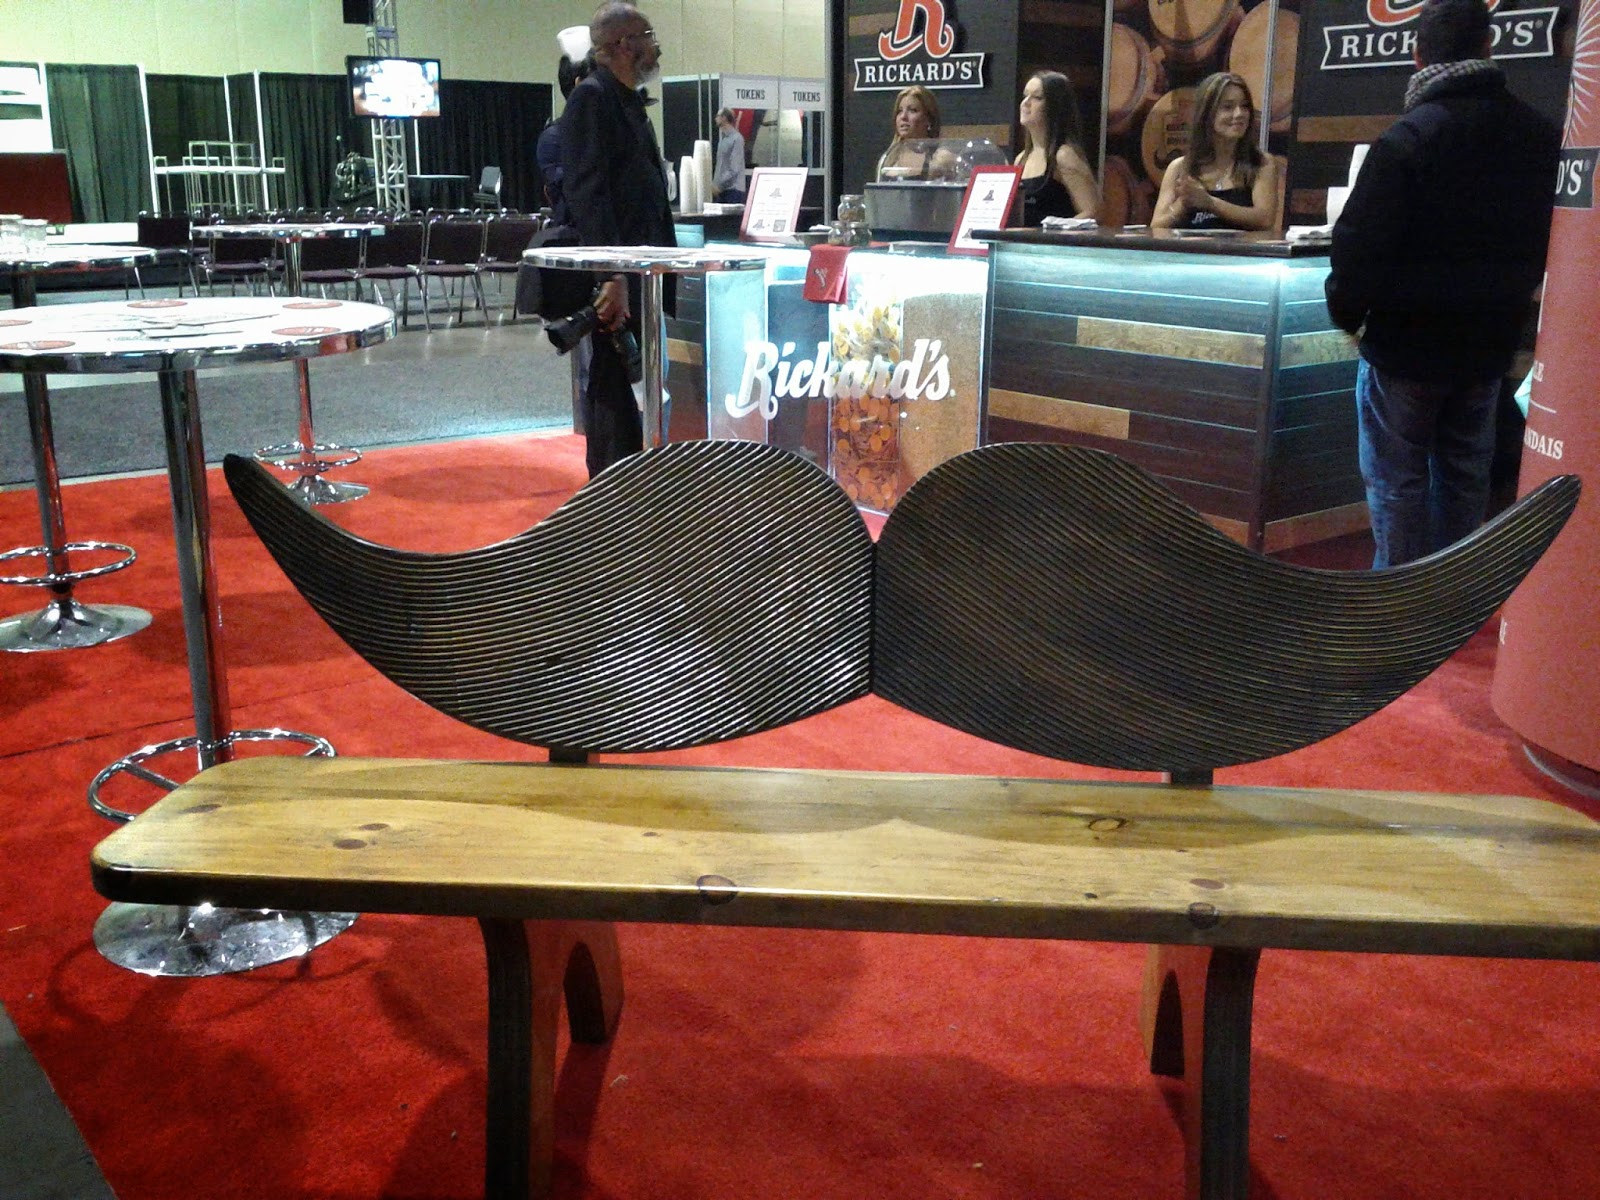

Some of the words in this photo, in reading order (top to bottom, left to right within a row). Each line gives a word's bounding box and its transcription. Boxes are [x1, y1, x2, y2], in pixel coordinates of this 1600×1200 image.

[864, 60, 973, 84] RICKARD'S
[736, 88, 766, 100] TOKENS
[793, 91, 821, 102] TOKENS
[725, 338, 951, 421] Rickard's
